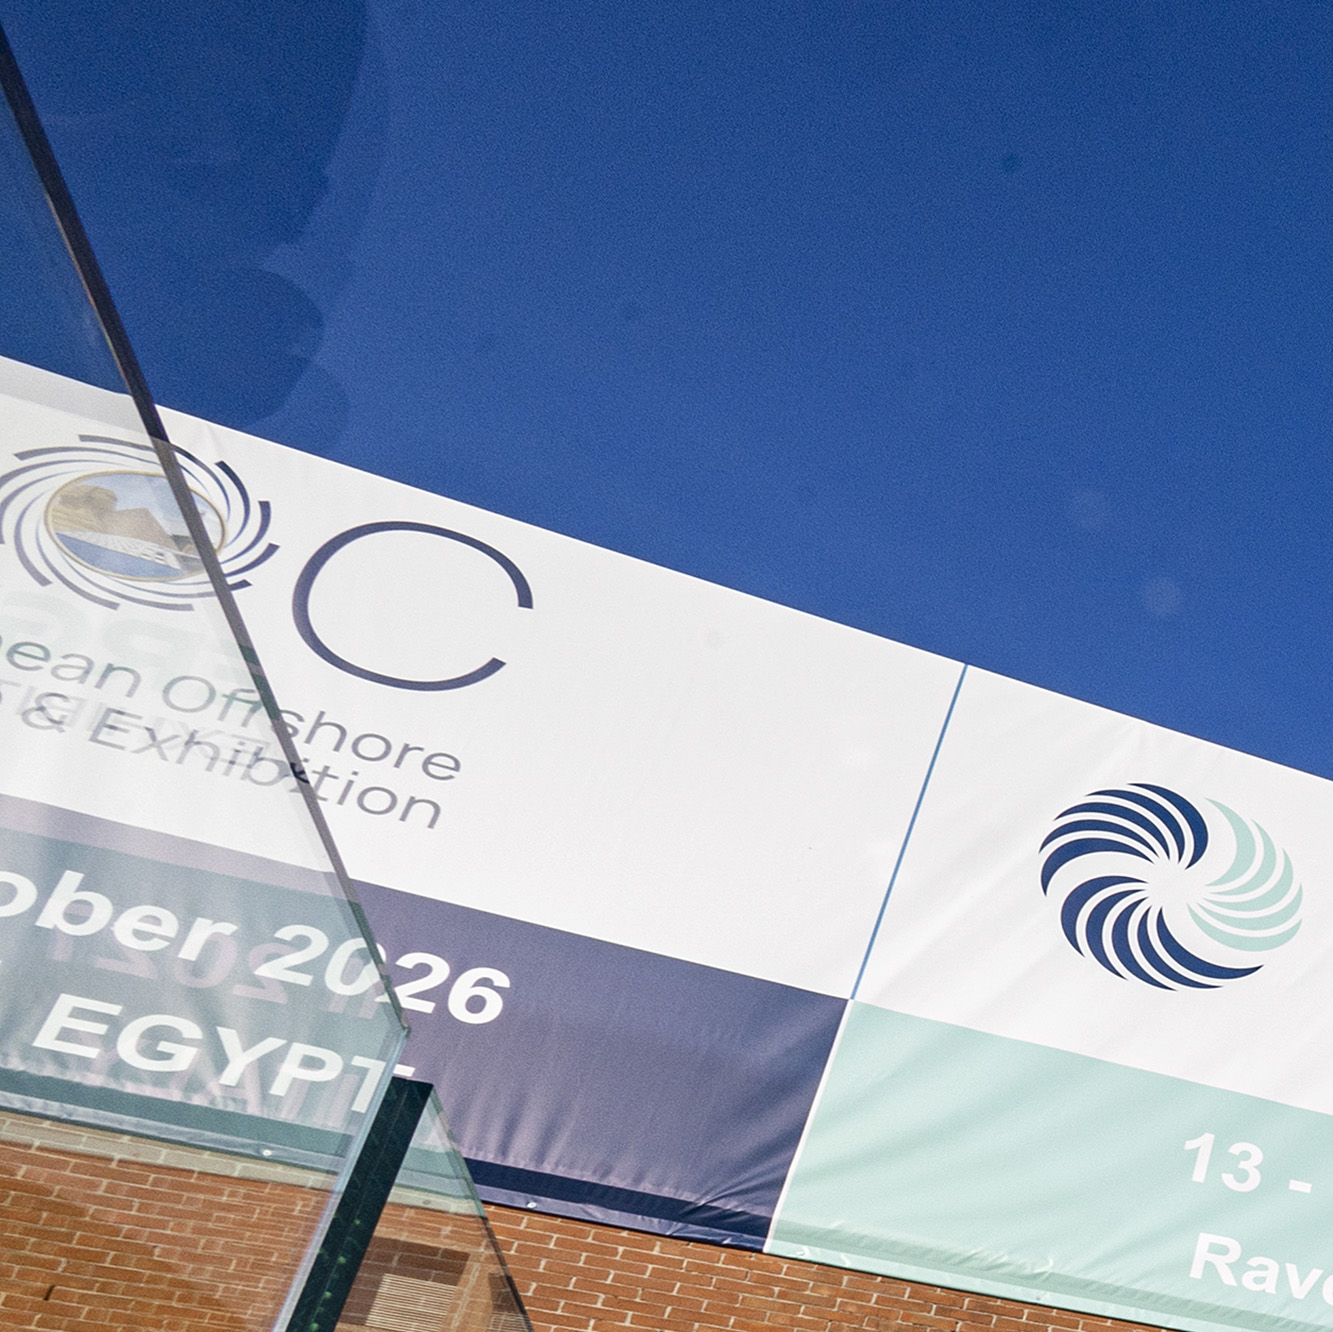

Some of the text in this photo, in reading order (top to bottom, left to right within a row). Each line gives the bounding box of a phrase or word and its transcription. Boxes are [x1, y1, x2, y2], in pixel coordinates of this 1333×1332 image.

[0, 636, 142, 698] ean
[21, 691, 71, 733] &
[252, 922, 513, 1026] 2026
[33, 993, 416, 1115] EGYPT
[1181, 1131, 1266, 1194] 13
[1289, 1180, 1312, 1194] -
